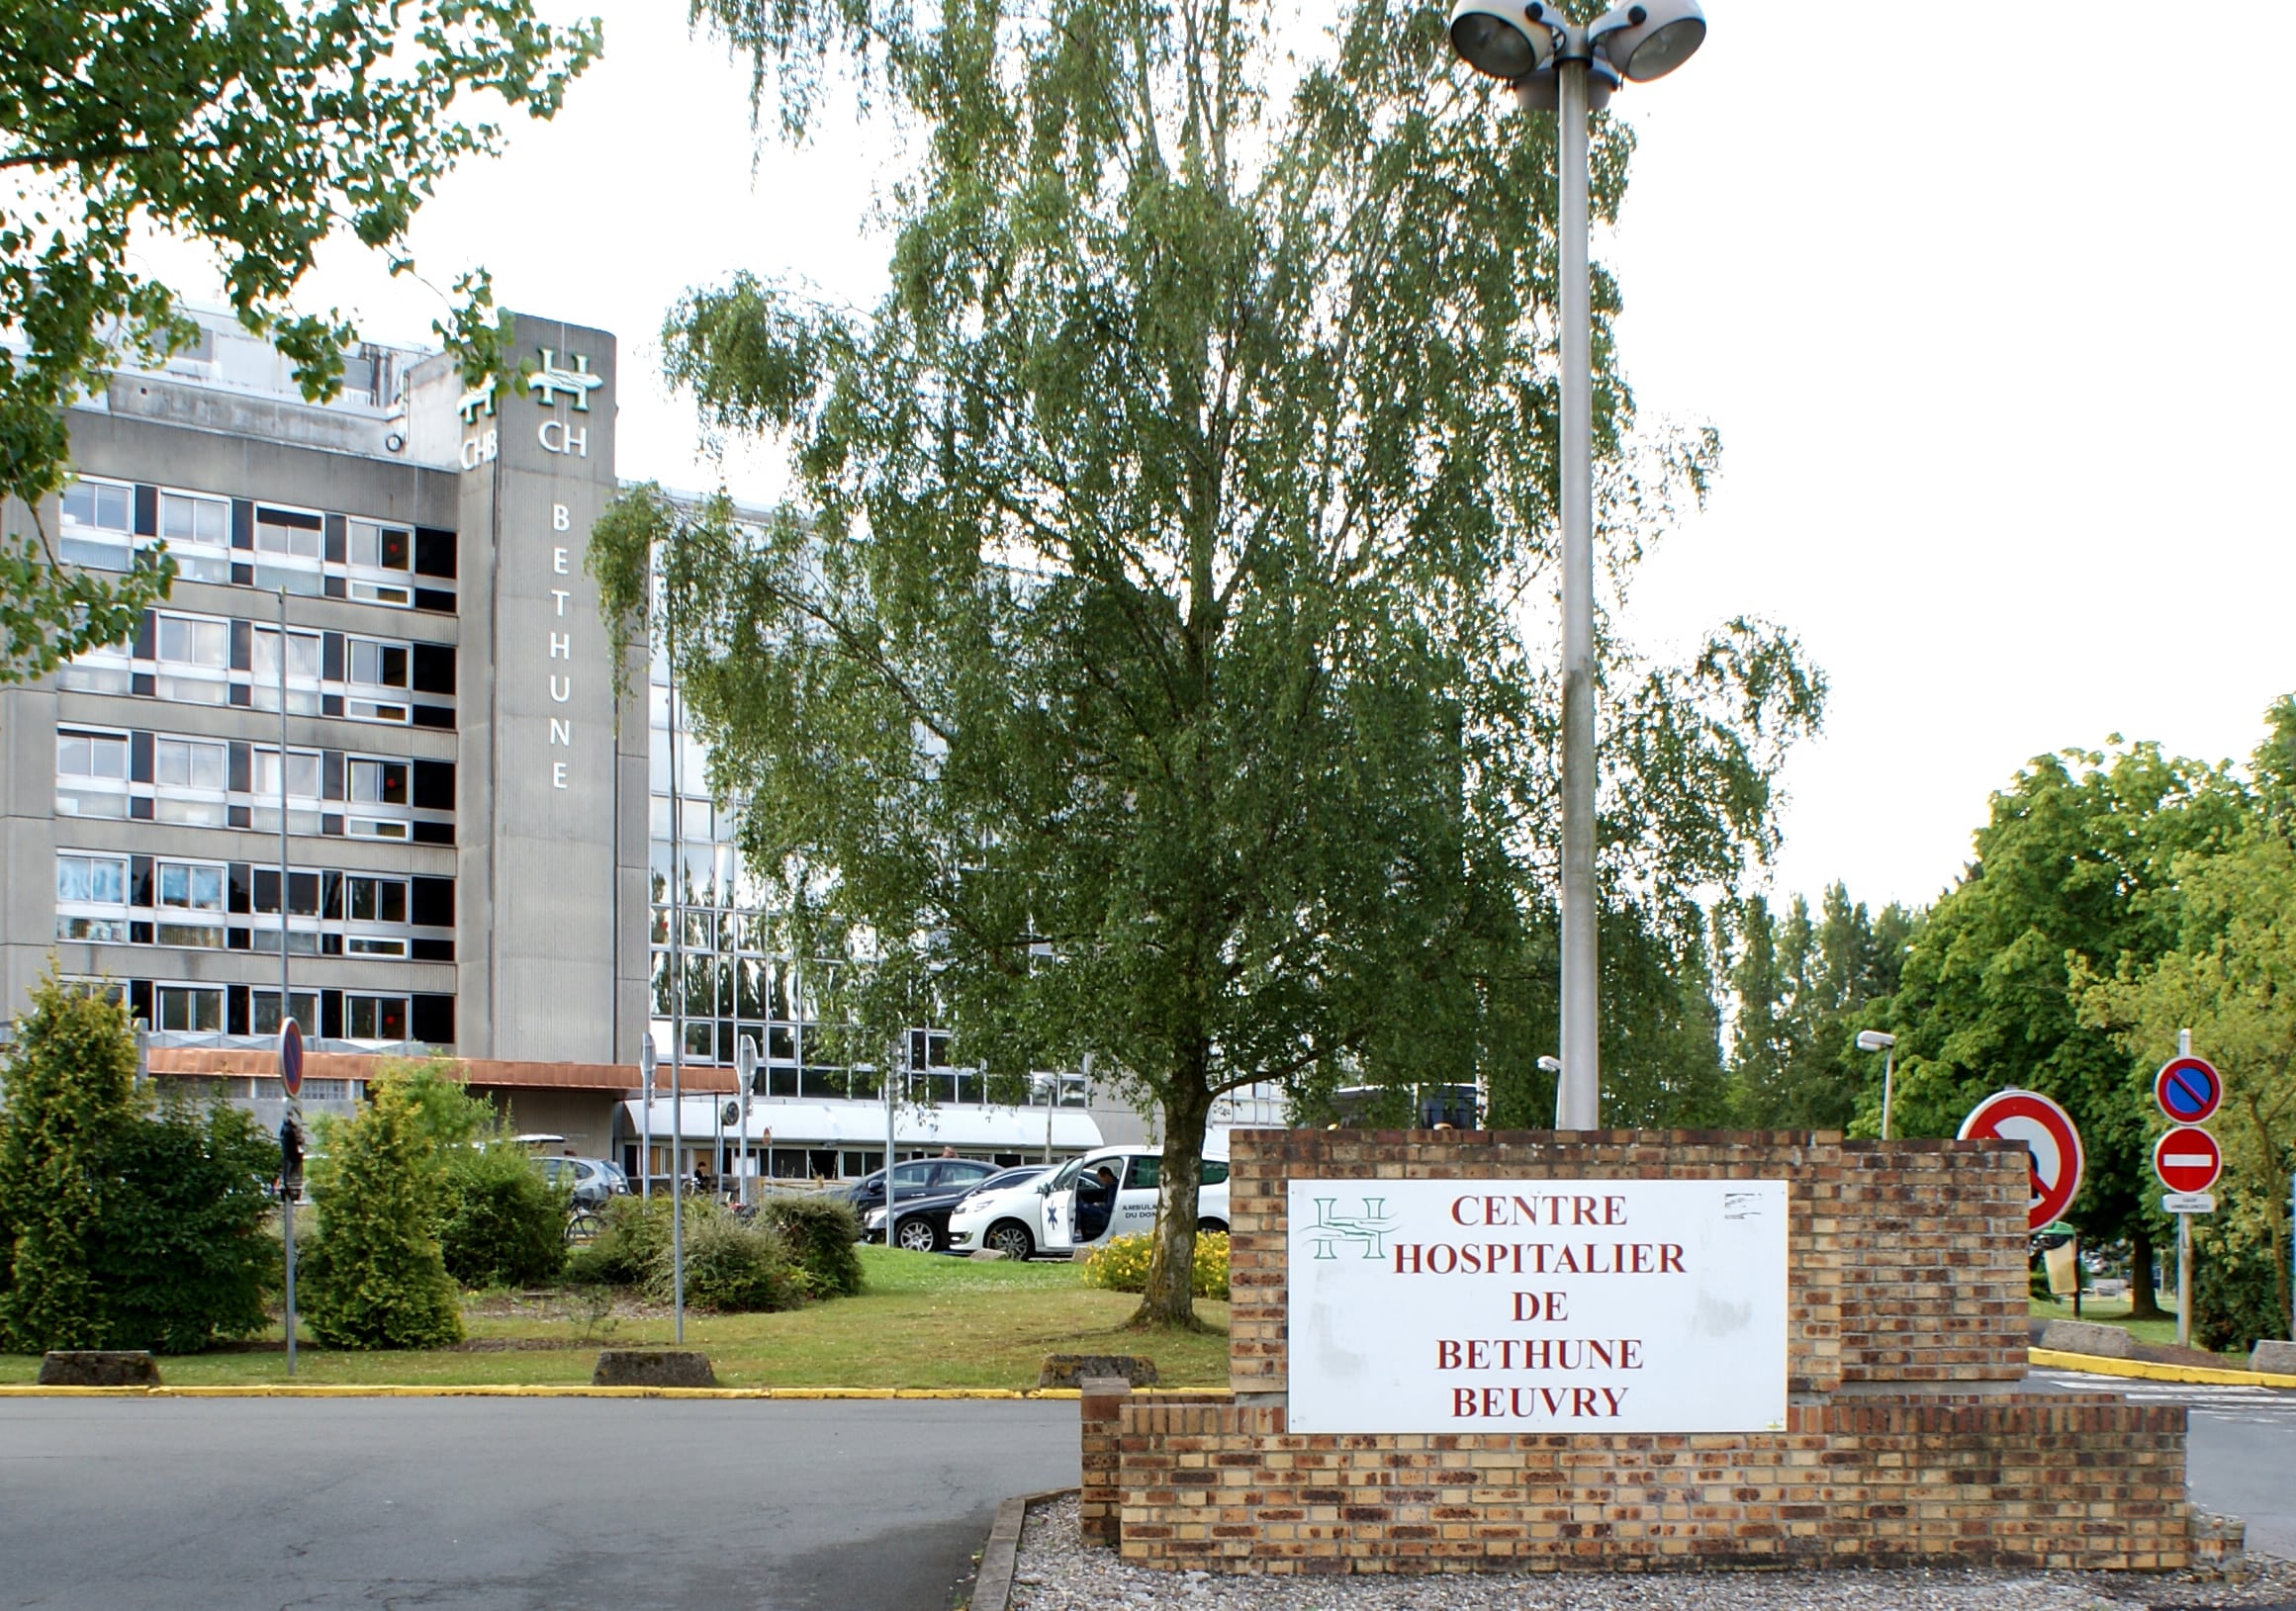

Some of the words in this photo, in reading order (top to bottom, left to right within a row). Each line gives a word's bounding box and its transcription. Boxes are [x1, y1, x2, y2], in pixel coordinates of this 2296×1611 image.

[461, 428, 498, 471] CHB
[538, 420, 587, 458] CH
[550, 503, 571, 789] BETHUNE
[1450, 1195, 1627, 1226] CENTRE
[1393, 1243, 1688, 1275] HOSPITALIER
[1512, 1291, 1568, 1322] DE
[1436, 1338, 1644, 1371] BETHUNE
[1451, 1386, 1629, 1419] BEUVRY
